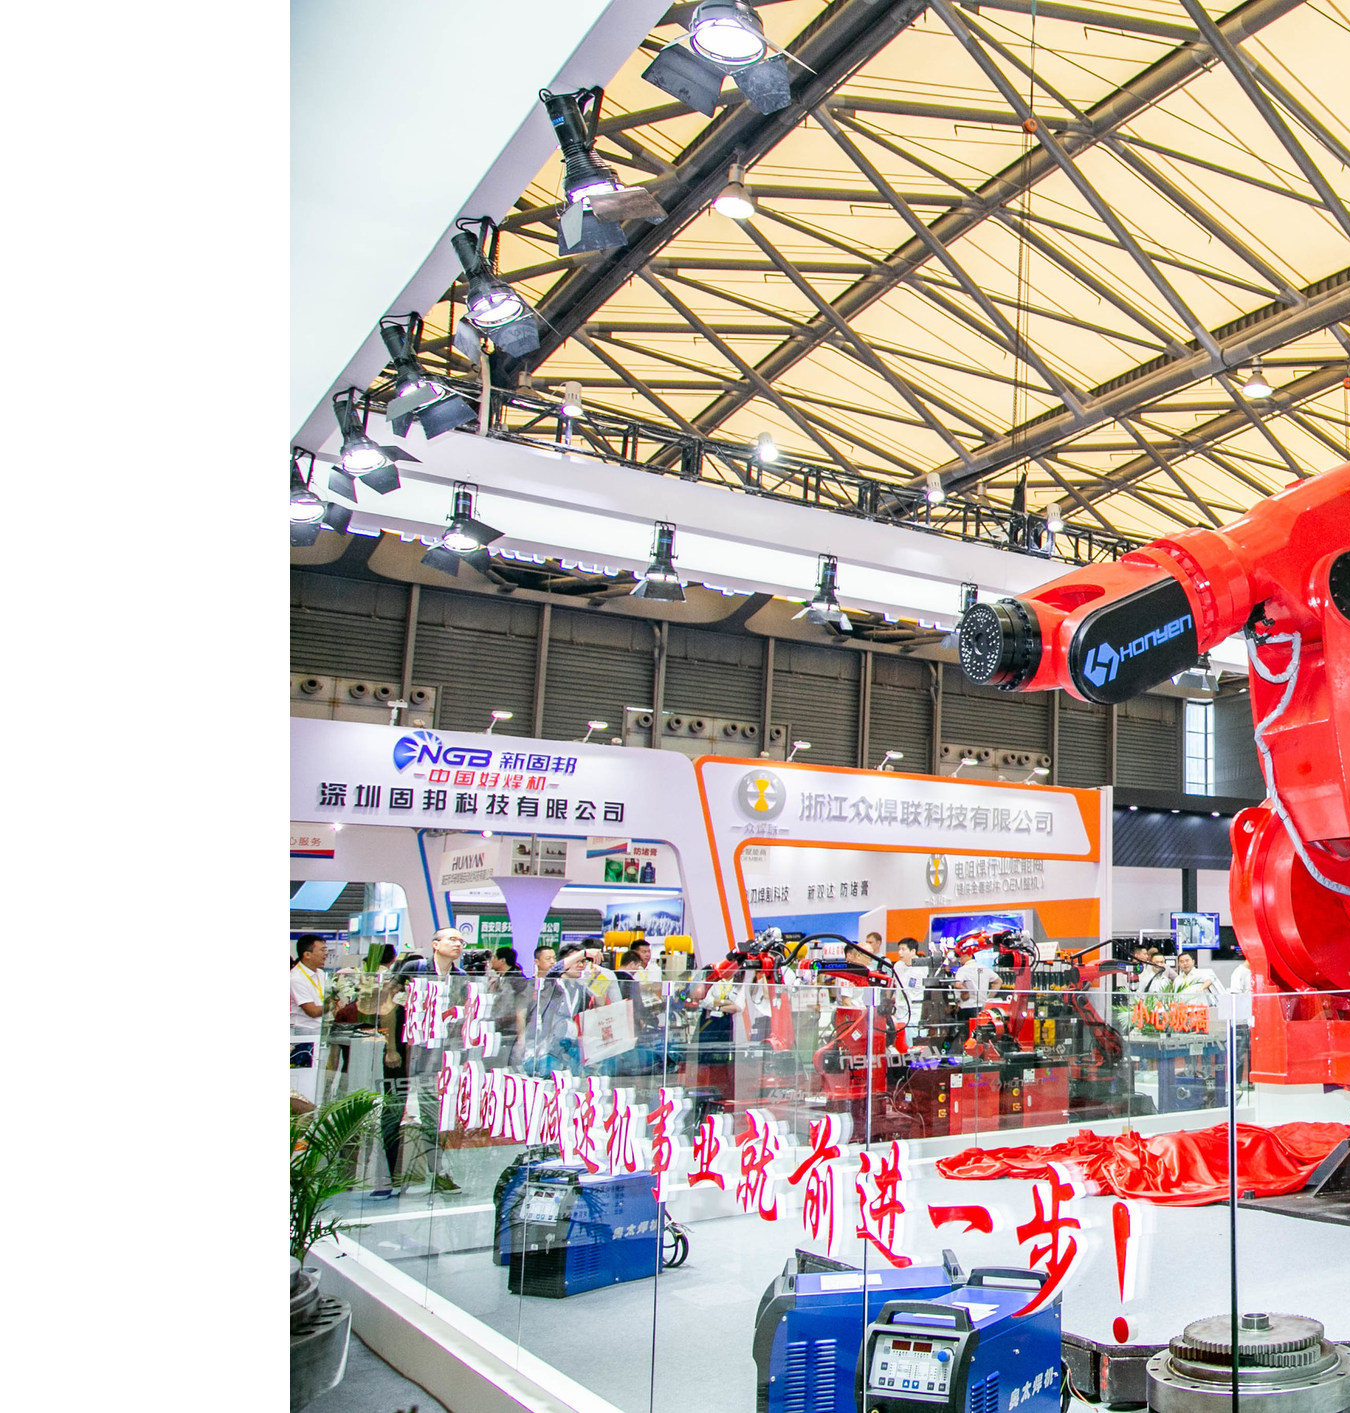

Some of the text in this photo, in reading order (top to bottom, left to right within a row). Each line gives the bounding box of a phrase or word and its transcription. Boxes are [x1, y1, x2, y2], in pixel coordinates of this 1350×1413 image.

[417, 746, 577, 774] NGB 新固邦
[428, 769, 546, 790] 中国好焊机
[319, 782, 625, 823] 深圳固邦科技有限公司
[798, 791, 1054, 836] 浙江众焊联科技有限公司
[1131, 999, 1210, 1034] 小心玻璃
